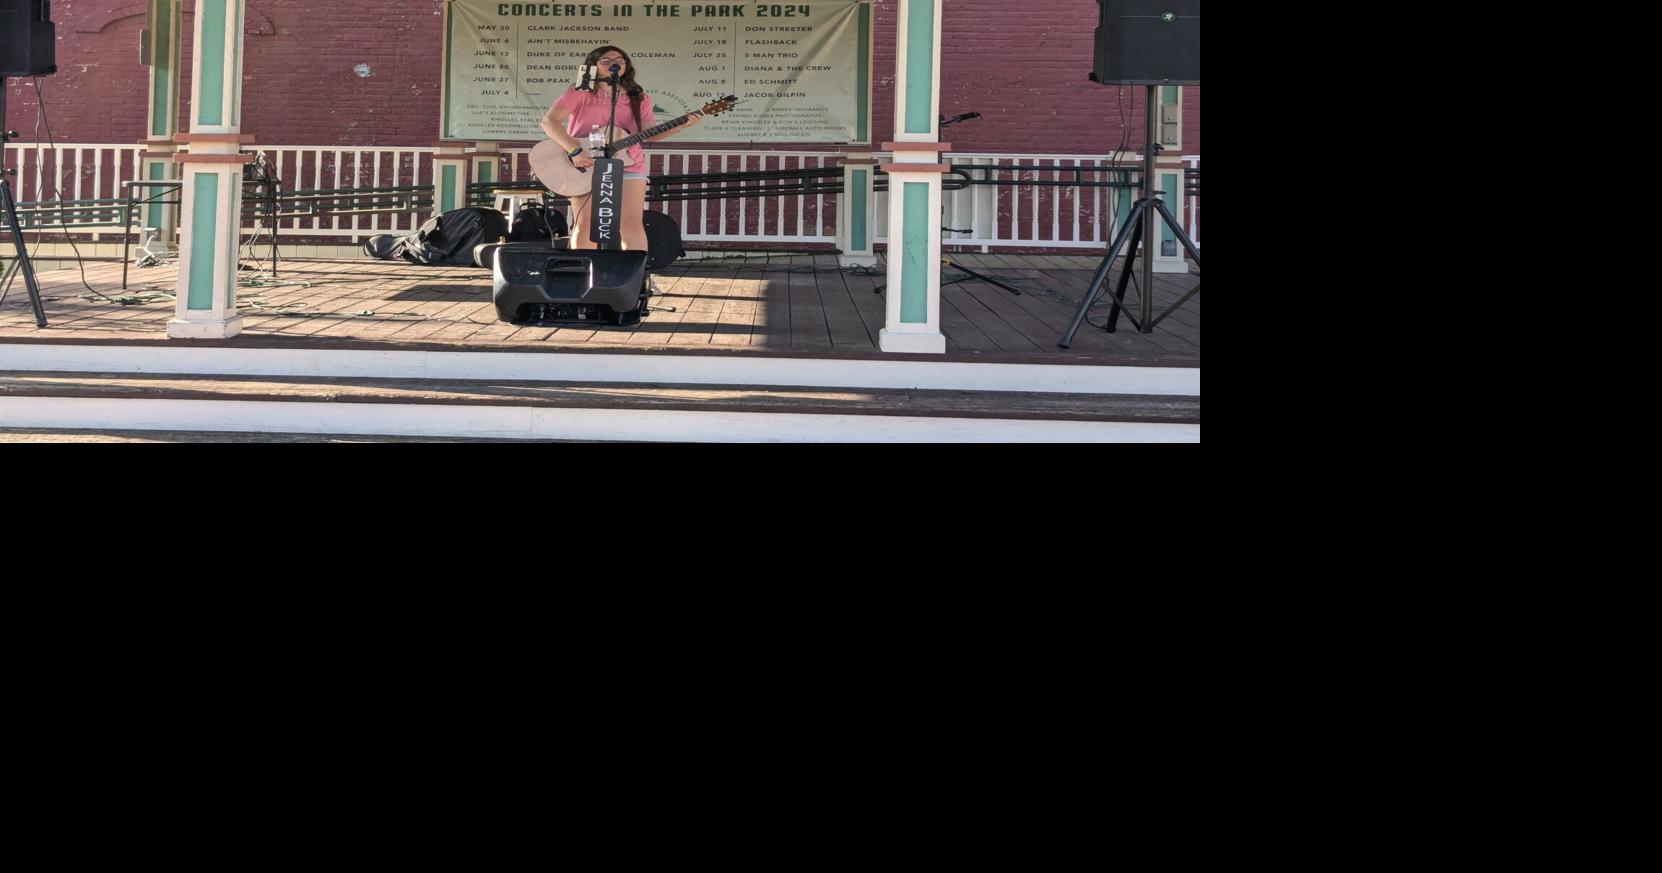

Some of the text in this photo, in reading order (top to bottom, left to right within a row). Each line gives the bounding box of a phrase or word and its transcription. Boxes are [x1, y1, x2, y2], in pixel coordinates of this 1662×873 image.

[498, 4, 810, 16] CONCERTS IN THE PARK 2024
[598, 163, 613, 239] JENNA BUCK
